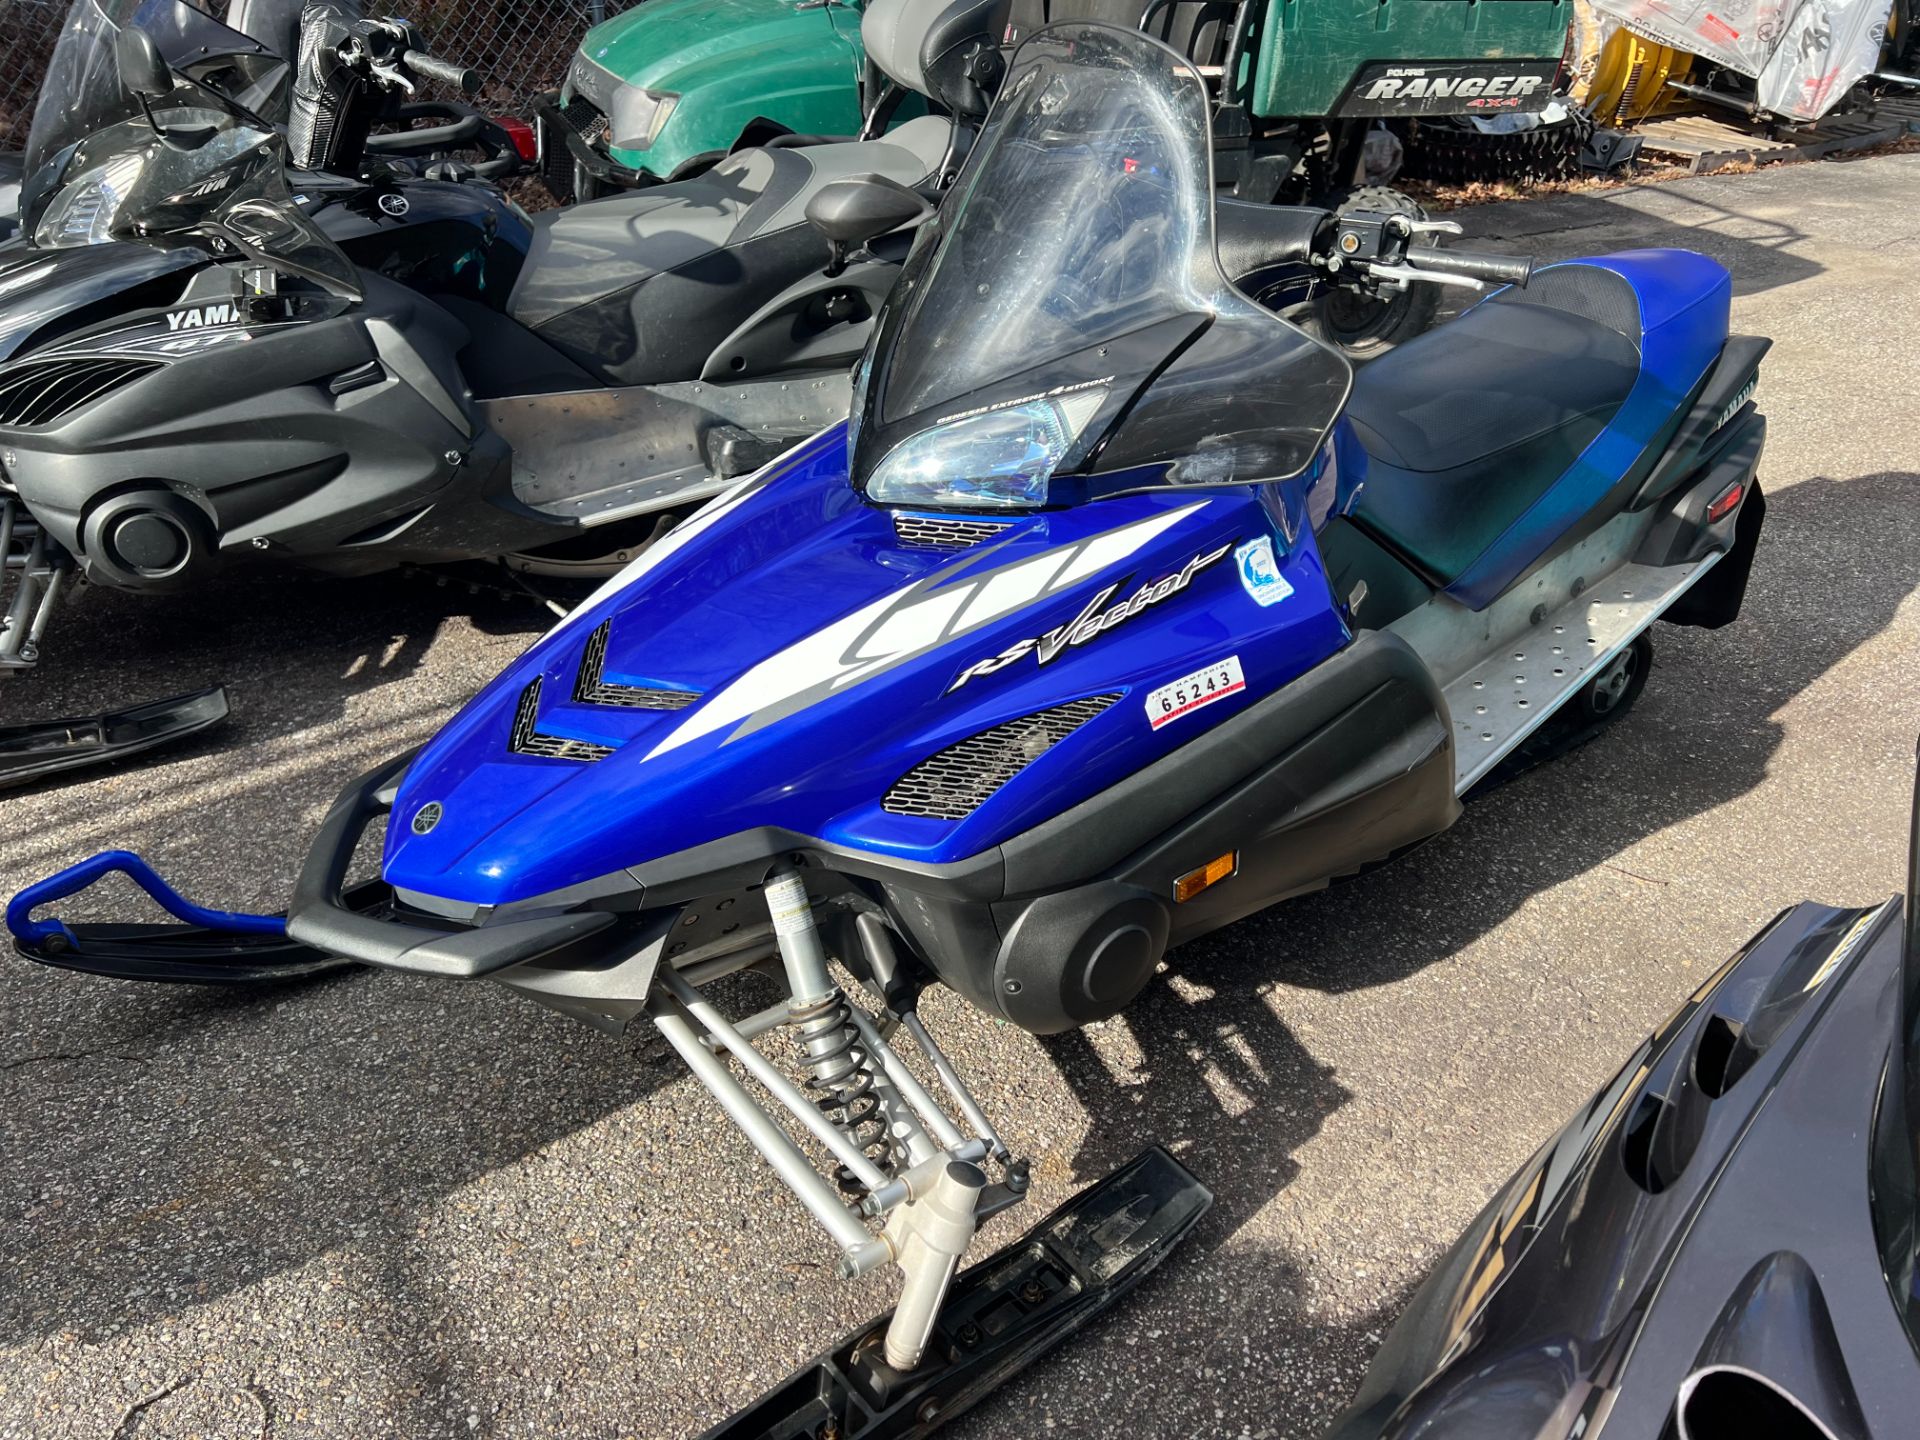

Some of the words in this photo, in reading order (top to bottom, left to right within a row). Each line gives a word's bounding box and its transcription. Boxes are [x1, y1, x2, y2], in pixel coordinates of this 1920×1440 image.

[1386, 68, 1426, 77] POLARIS
[1365, 75, 1543, 100] RANGER
[936, 405, 990, 425] GENESIS
[991, 391, 1047, 411] EXTREME
[1036, 543, 1233, 666] Vector
[1176, 661, 1231, 687] HAMPSHIRE
